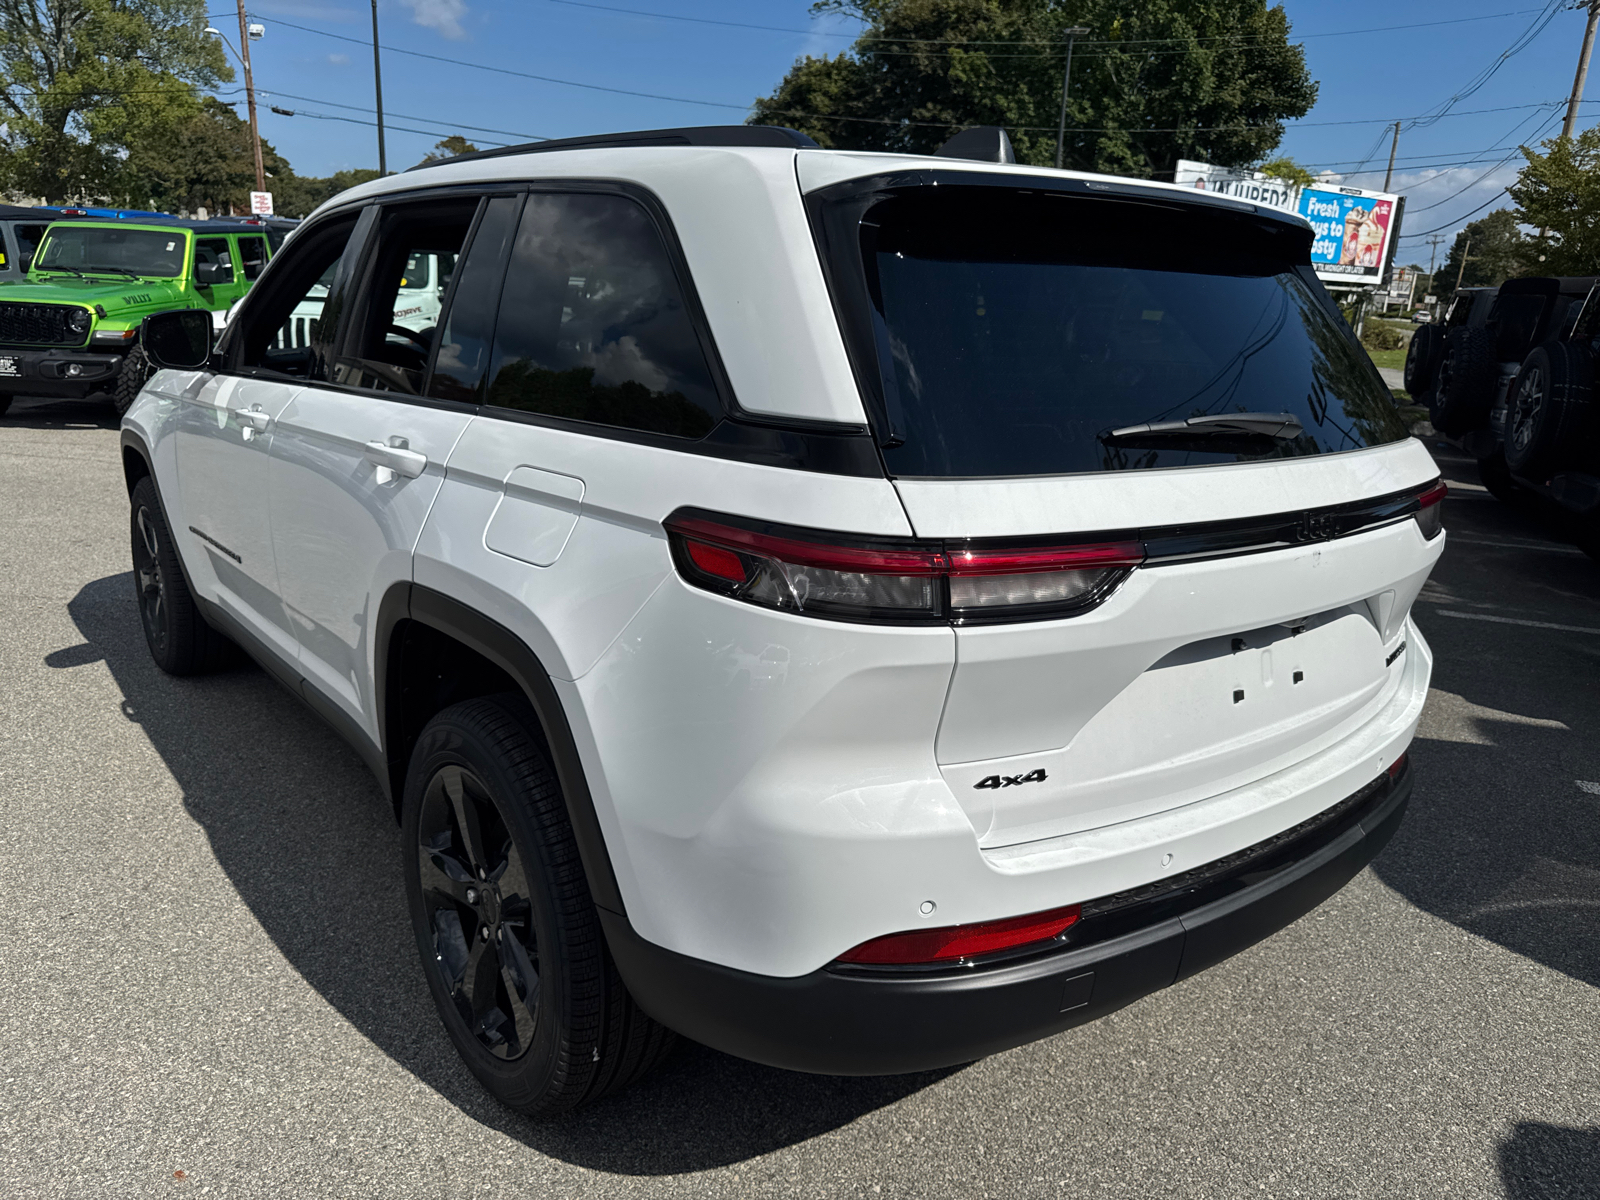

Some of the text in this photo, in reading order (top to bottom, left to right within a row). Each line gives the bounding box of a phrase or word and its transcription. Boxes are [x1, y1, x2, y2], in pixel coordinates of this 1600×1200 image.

[1307, 197, 1340, 218] Fresh
[1305, 216, 1343, 240] ays to
[1297, 511, 1339, 542] Jeep
[973, 768, 1049, 790] 4x4
